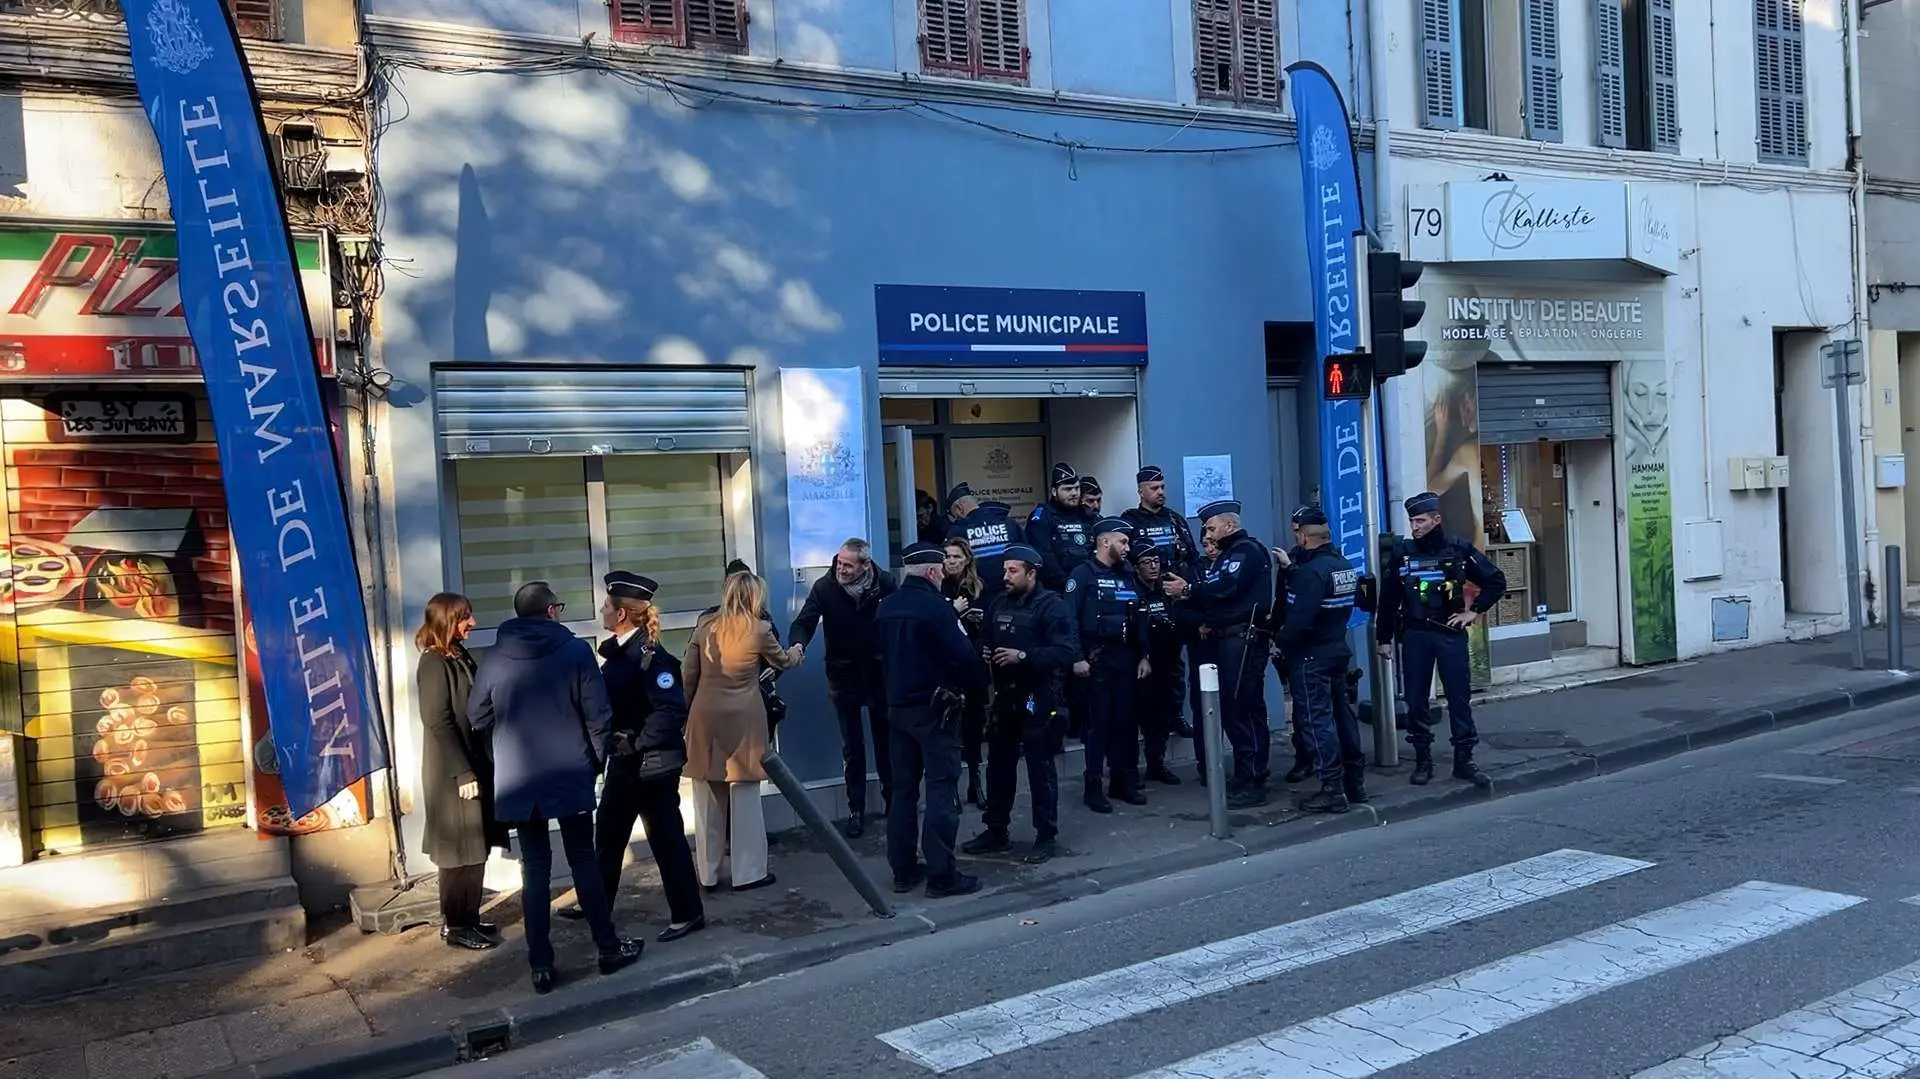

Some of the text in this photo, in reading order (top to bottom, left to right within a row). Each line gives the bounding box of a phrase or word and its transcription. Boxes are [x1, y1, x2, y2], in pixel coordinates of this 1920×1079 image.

[1410, 208, 1442, 236] 79
[1447, 297, 1643, 322] INSTITUT DE BEAUTÉ
[910, 312, 1120, 334] POLICE MUNICIPALE
[1442, 327, 1507, 340] MODELAGE
[1591, 328, 1643, 340] ONGLERIE
[102, 400, 138, 417] BY
[64, 417, 179, 433] LES JUMEAUX
[1631, 462, 1665, 474] HAMMAM
[968, 486, 1034, 497] OLICE MUNICIPALE
[966, 523, 1007, 539] POLICE
[968, 534, 1009, 547] MUNICIPALE
